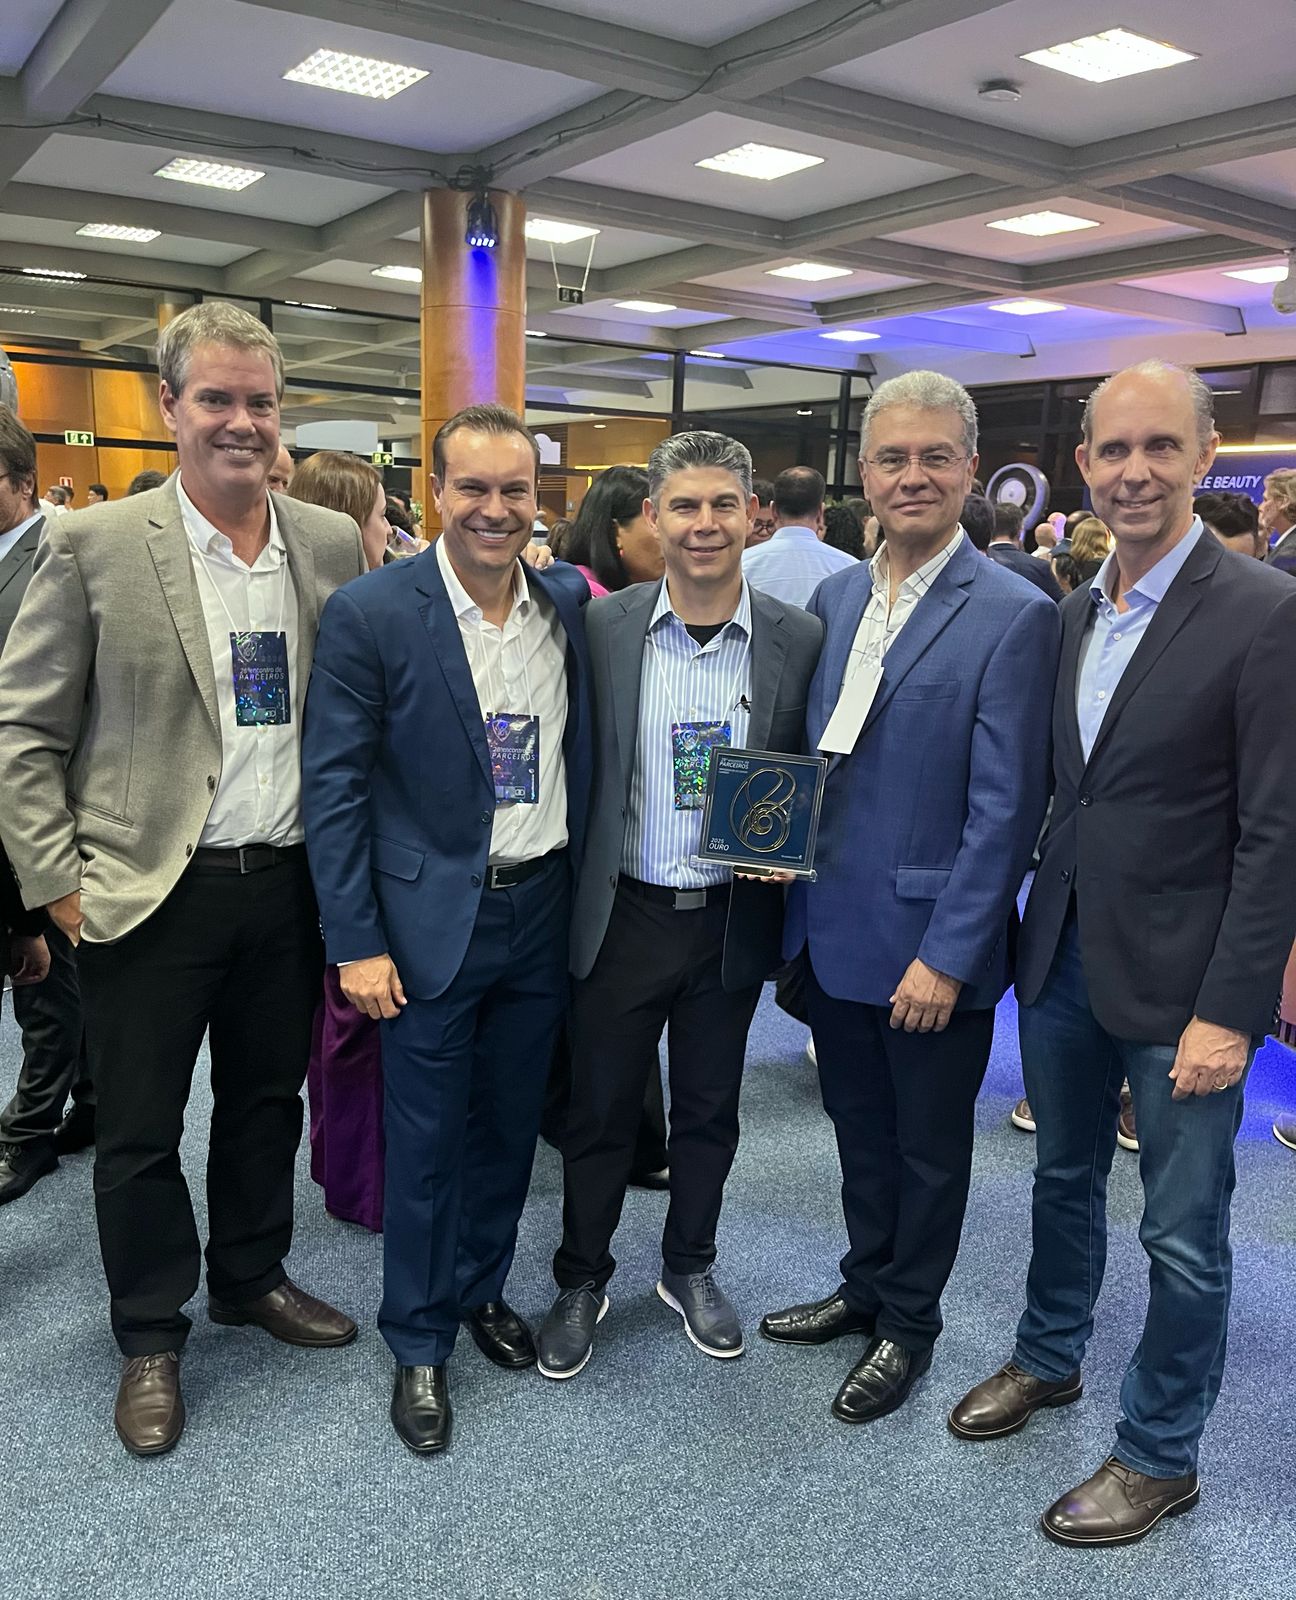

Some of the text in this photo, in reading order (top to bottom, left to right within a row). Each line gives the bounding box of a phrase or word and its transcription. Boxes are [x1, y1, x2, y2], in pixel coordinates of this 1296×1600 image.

[1213, 476, 1261, 488] BEAUTY
[239, 672, 285, 680] PARCEIROS
[491, 752, 535, 760] PARCEIROS
[719, 761, 749, 770] PARCEIROS
[709, 842, 729, 851] OURO
